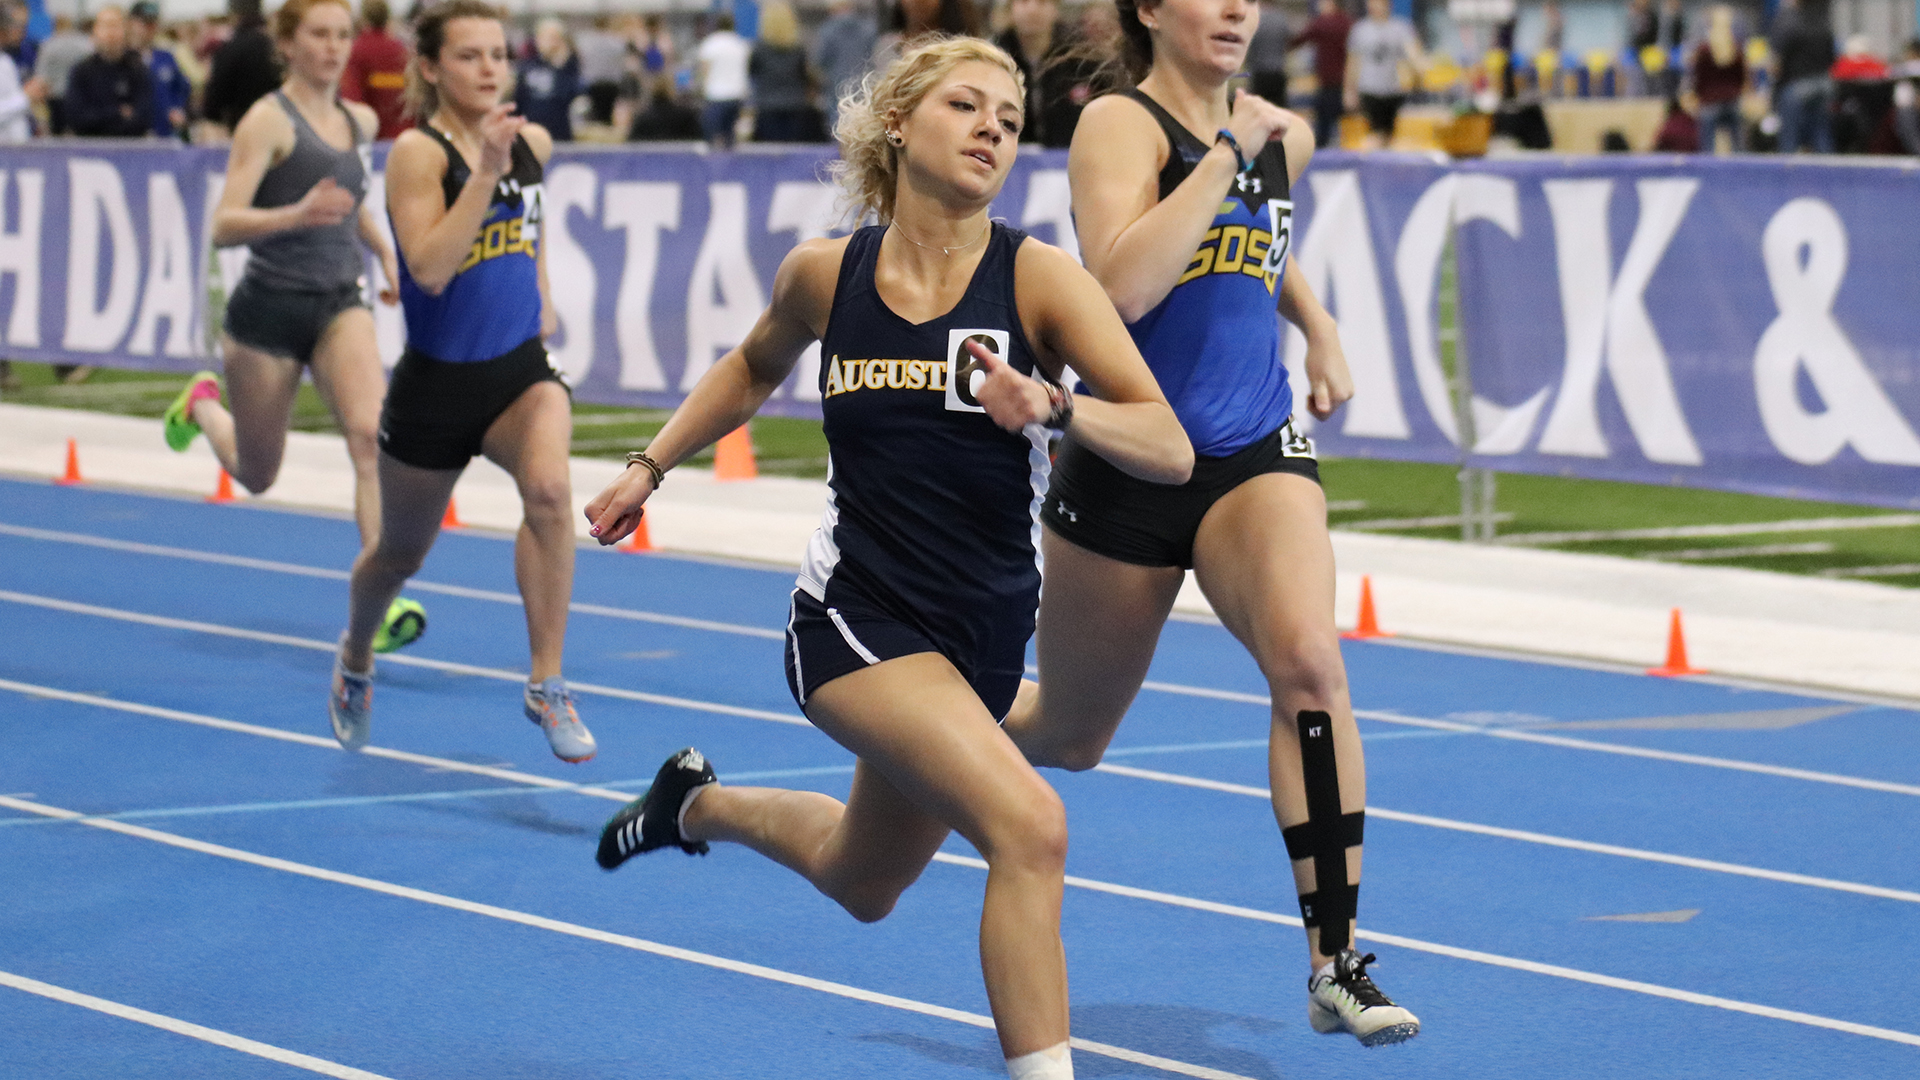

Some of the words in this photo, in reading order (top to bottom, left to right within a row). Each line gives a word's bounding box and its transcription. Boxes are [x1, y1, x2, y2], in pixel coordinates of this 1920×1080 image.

[1175, 224, 1279, 297] SDS
[1268, 206, 1293, 268] 5
[545, 162, 880, 402] STAT
[1753, 197, 1920, 466] &
[825, 354, 948, 399] AUGUST
[1308, 725, 1323, 738] KT
